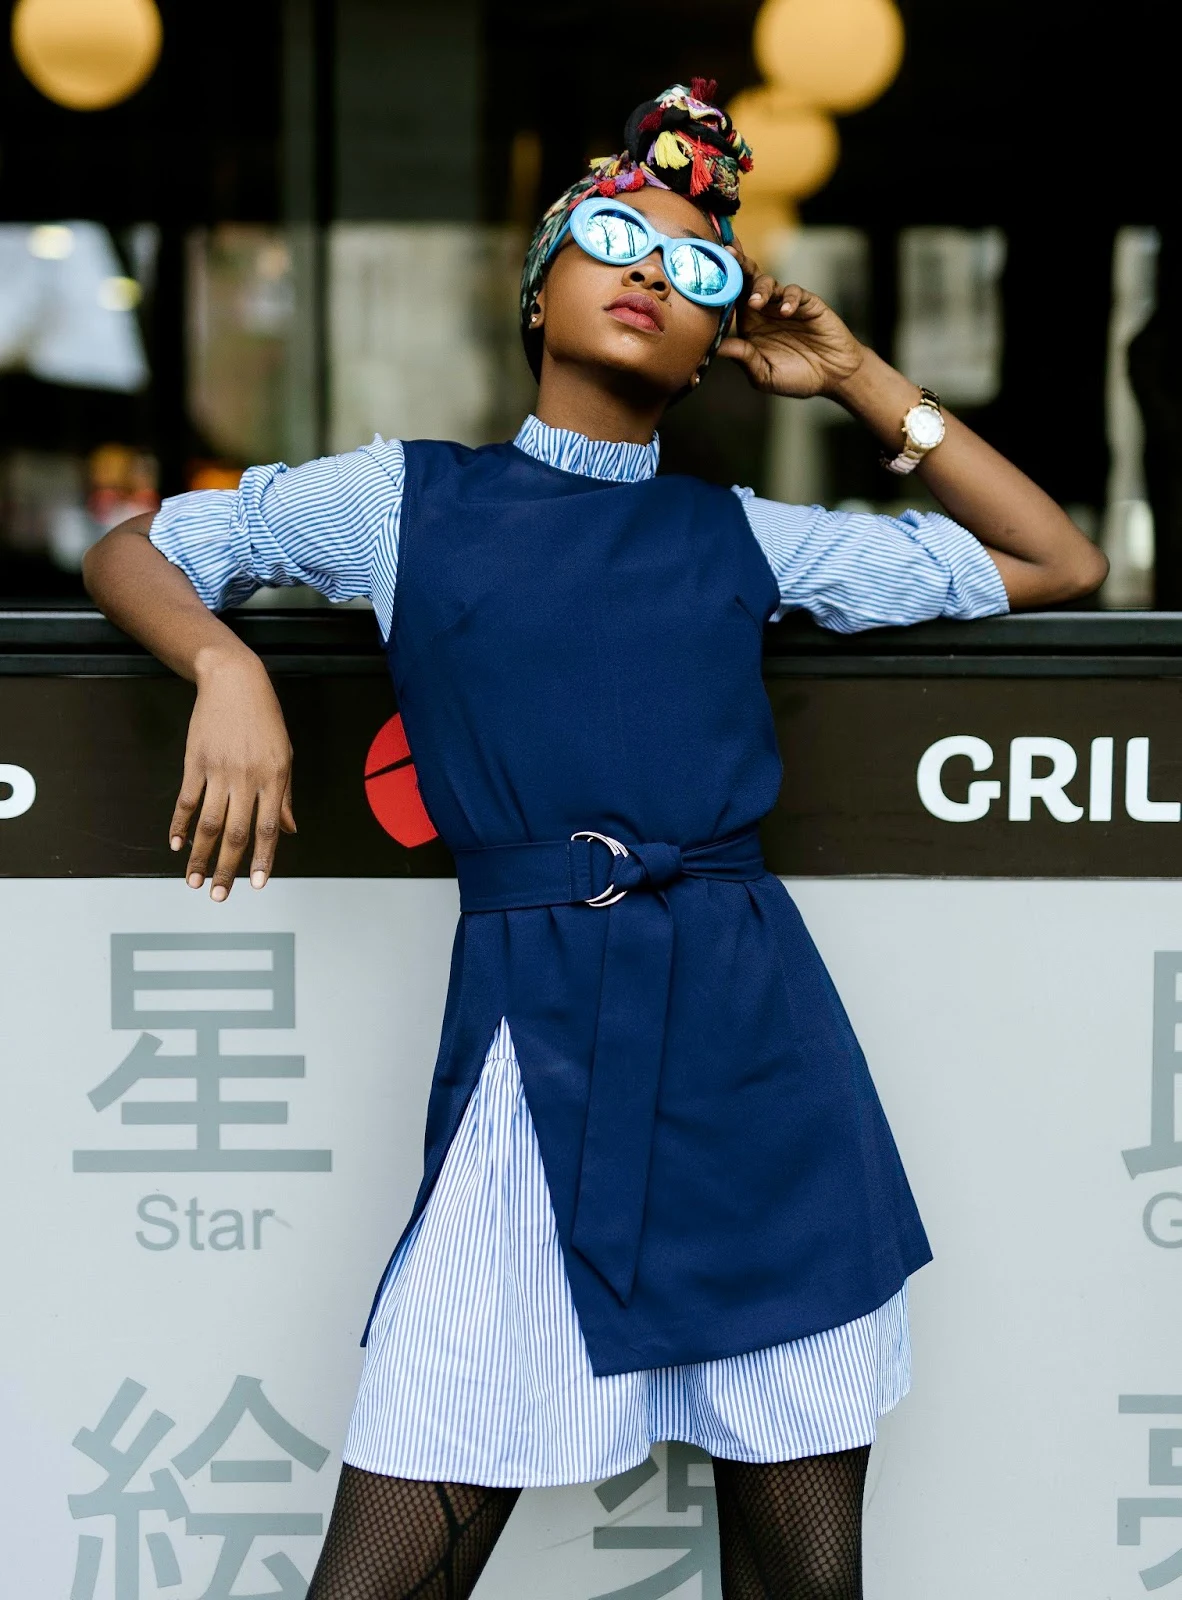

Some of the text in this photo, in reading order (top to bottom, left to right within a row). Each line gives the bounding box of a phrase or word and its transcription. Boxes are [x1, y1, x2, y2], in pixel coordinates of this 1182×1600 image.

[916, 735, 1181, 822] GRIL
[72, 932, 333, 1173] 星
[135, 1193, 276, 1251] Star
